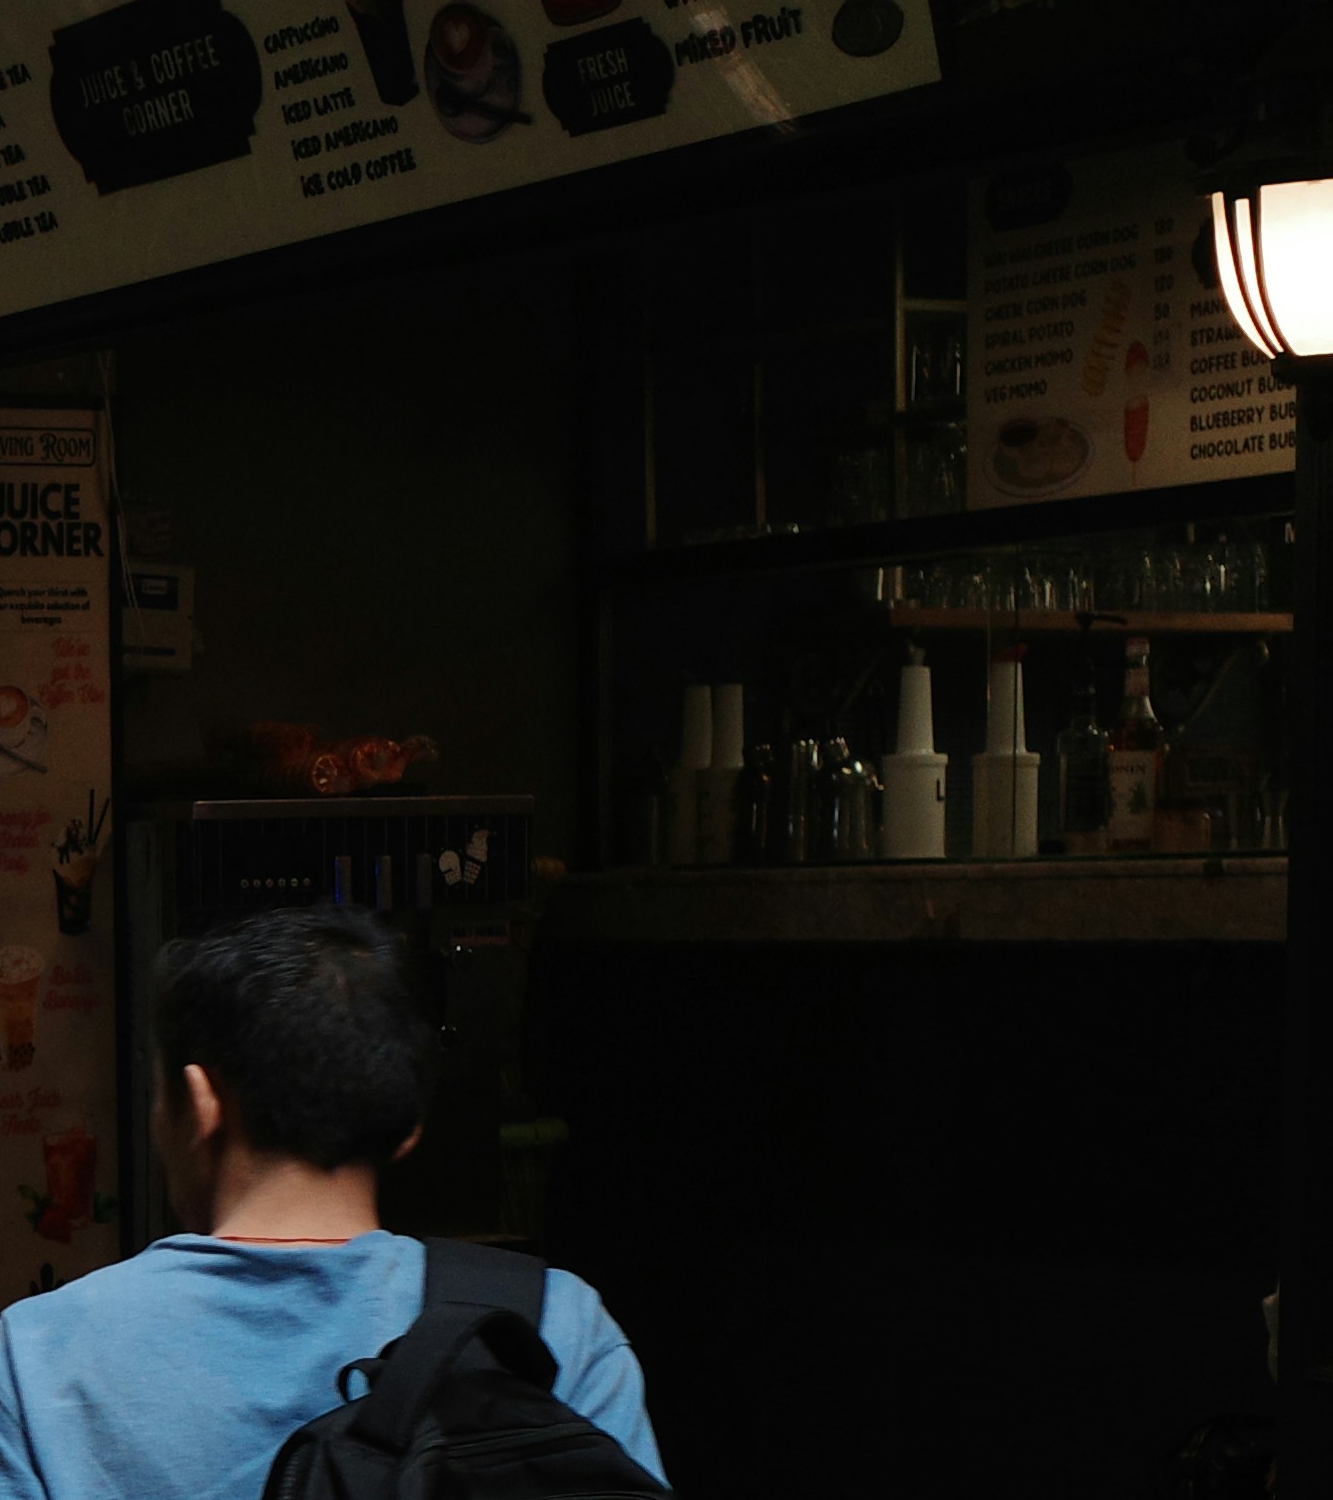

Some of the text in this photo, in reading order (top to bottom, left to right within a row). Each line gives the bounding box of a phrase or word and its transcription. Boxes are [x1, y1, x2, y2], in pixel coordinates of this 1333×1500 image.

[7, 63, 32, 85] TEA
[79, 34, 221, 109] JUICE & COFFEE
[577, 46, 630, 82] FRESH
[589, 81, 636, 117] JUICE
[121, 87, 196, 138] CORNER
[0, 144, 25, 166] TEA
[366, 148, 417, 181] COFFEE
[27, 174, 52, 197] TEA
[34, 211, 59, 233] TEA
[1029, 320, 1075, 342] POTATO
[985, 356, 1032, 376] CHICKEN
[1190, 353, 1237, 375] COFFEE
[1190, 378, 1252, 404] COCONUT
[1190, 406, 1265, 432] BLUEBERRY
[1190, 434, 1265, 460] CHOCOLATE
